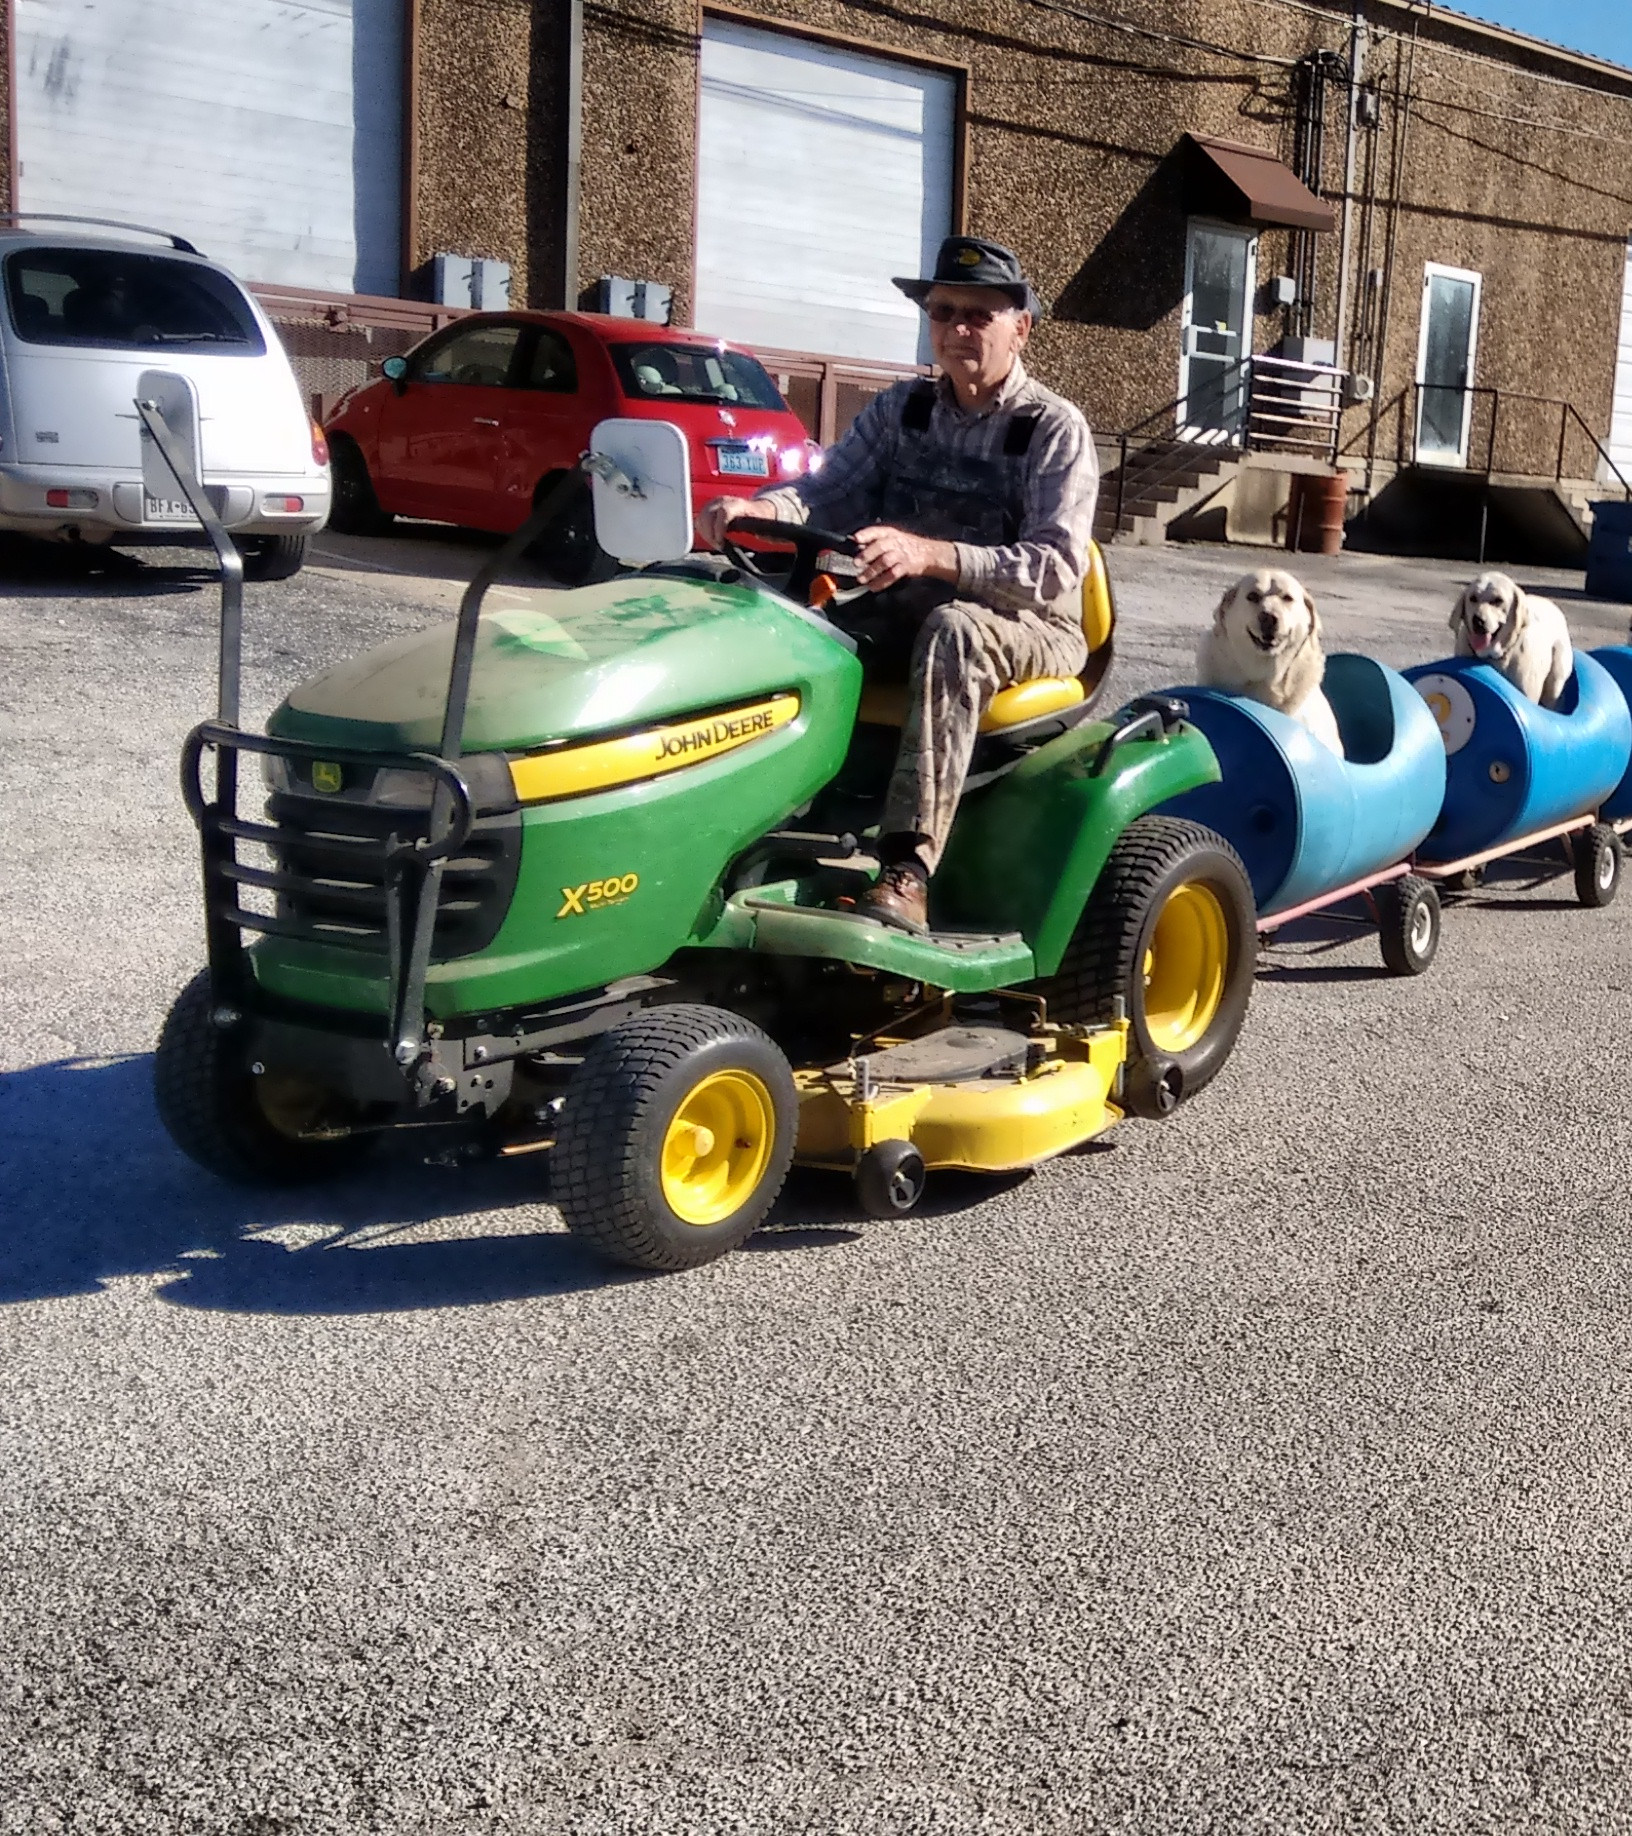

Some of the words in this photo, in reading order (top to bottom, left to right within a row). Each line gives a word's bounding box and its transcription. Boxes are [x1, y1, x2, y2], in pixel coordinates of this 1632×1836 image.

[722, 454, 742, 470] 363
[655, 728, 712, 761] JOHN
[712, 709, 774, 744] DEERE
[556, 873, 639, 918] X500
